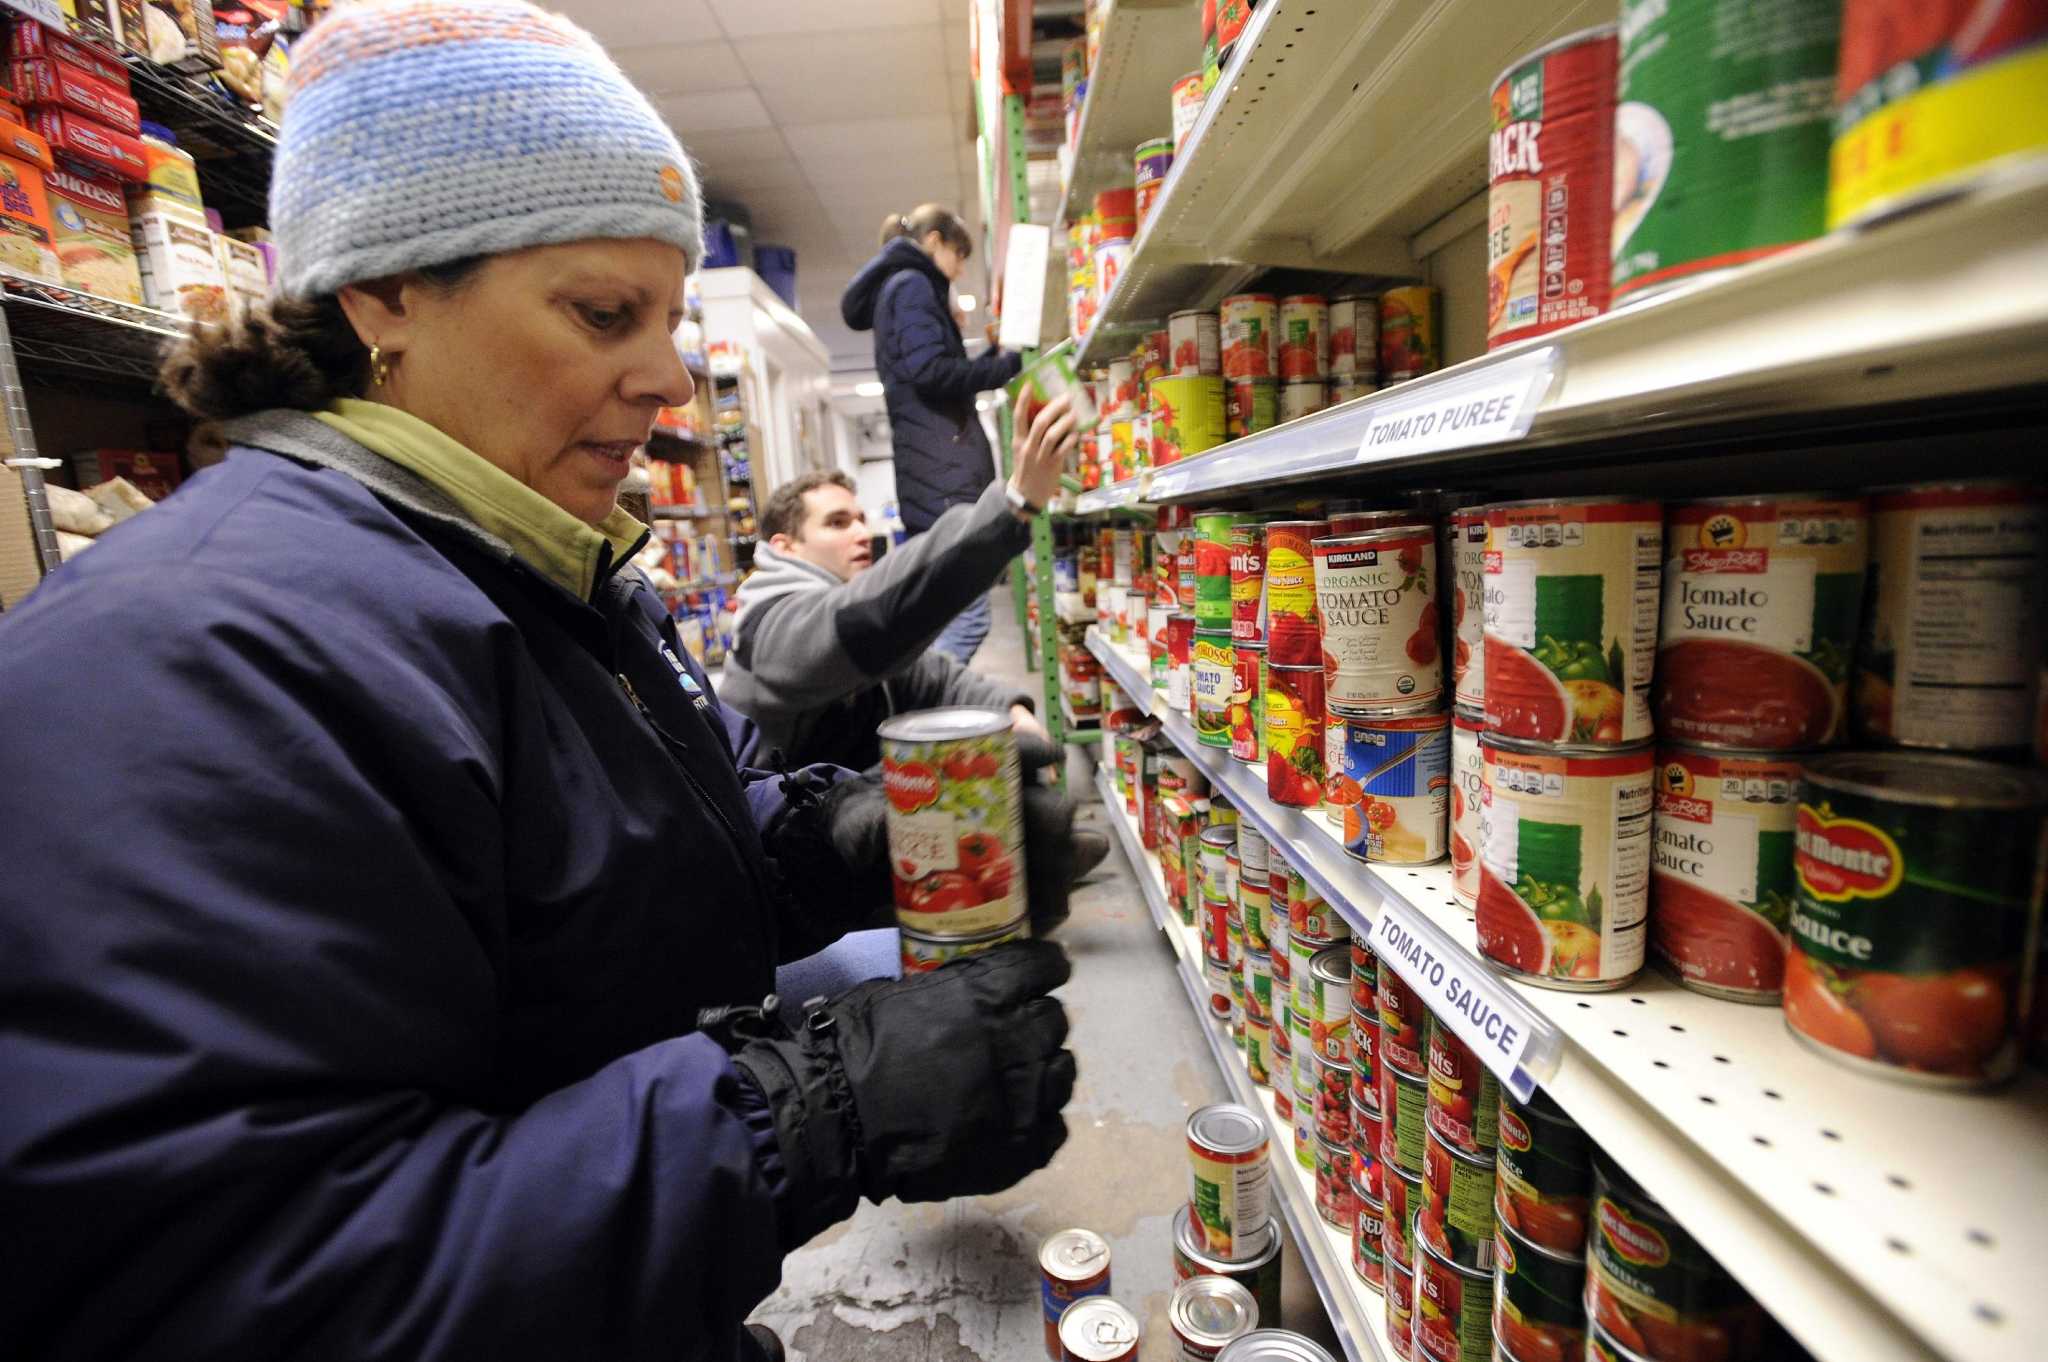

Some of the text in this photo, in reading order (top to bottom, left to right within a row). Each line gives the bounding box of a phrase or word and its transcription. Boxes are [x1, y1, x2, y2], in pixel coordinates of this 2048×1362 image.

[1368, 394, 1516, 446] TOMATO PUREE
[1327, 551, 1377, 563] KIRKLAND
[1687, 550, 1763, 574] ShopRite
[1322, 572, 1391, 589] ORGANIC
[1319, 588, 1401, 610] TOMATO
[1680, 581, 1769, 608] Tomato
[1327, 607, 1390, 626] SAUCE
[1684, 605, 1757, 633] Sauce
[1727, 779, 1739, 791] 20
[1811, 833, 1891, 880] Monte
[1379, 914, 1519, 1056] TOMATO SAUCE
